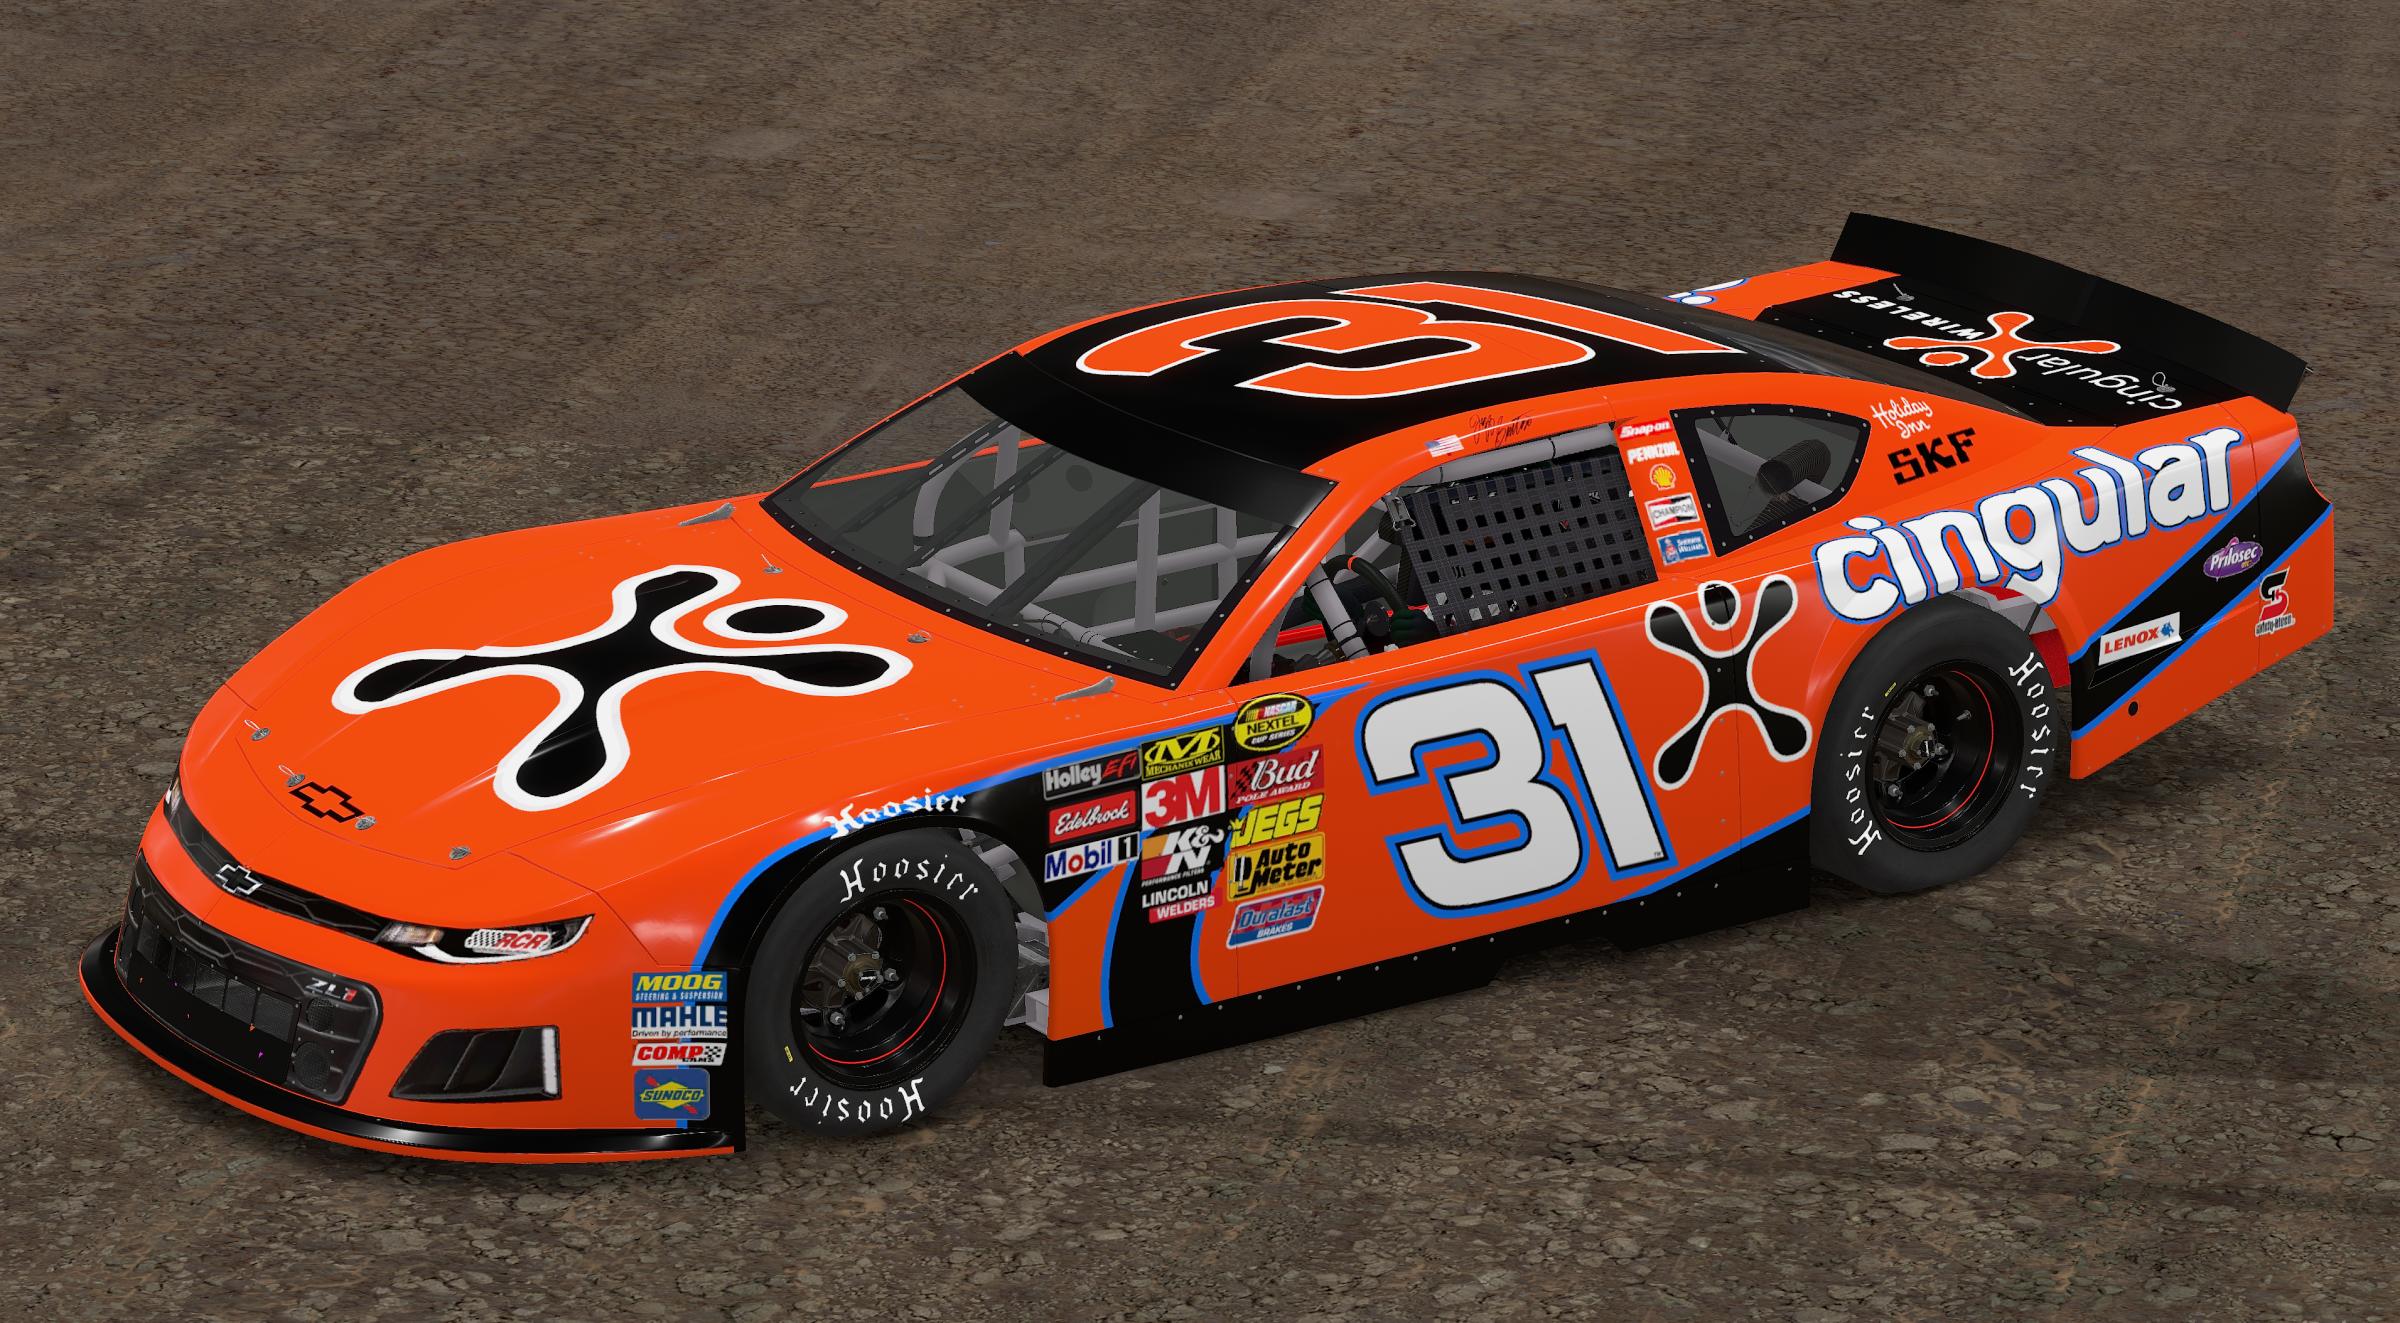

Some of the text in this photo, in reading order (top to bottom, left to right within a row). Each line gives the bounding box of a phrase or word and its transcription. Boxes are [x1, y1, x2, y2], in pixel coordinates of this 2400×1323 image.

[1832, 290, 1985, 340] WIRELESS
[1076, 281, 1746, 399] 31
[2017, 353, 2183, 410] cingular
[1870, 396, 1933, 429] Holiday
[1620, 421, 1671, 439] Snap-on
[1895, 419, 1931, 439] Inn
[1888, 427, 1976, 486] SKF
[1652, 503, 1694, 519] CHAMPION
[1813, 426, 2242, 624] cingular
[2210, 546, 2258, 571] Prilosec
[2104, 627, 2160, 655] LENOX
[1263, 700, 1298, 718] NASCAR
[1247, 715, 1299, 735] NEXTEL
[1251, 729, 1296, 745] CUP SERIES
[2008, 652, 2055, 798] Hoosier
[1194, 749, 1221, 764] WEAR
[1250, 749, 1319, 791] Bud
[1045, 751, 1137, 792] Holley EFI
[1357, 650, 1677, 917] 31
[1840, 706, 1882, 856] Hoosier
[1145, 766, 1220, 828] 3M
[1236, 781, 1311, 804] POLE AWARD
[820, 787, 966, 840] Hoosier
[1055, 800, 1129, 836] Edelbrock
[1230, 794, 1324, 848] JEGS
[1046, 836, 1132, 880] Mobil 1
[1256, 842, 1311, 869] Auto
[840, 854, 979, 903] Hoosier
[1253, 858, 1322, 888] Meter
[1142, 880, 1208, 909] LINCOLN
[1157, 896, 1215, 919] WELDERS
[1240, 896, 1314, 929] Duralast
[496, 932, 549, 950] RCR
[1256, 922, 1294, 939] BRAKES
[306, 977, 357, 1001] ZL1
[635, 991, 669, 1001] STEERING
[680, 991, 723, 1001] SUSPENSION
[636, 974, 724, 991] MOOG
[632, 1005, 727, 1028] MAHLE
[632, 1029, 727, 1038] Driven by performance
[637, 1046, 703, 1060] COMP
[643, 1090, 702, 1101] SUNOCO
[790, 1077, 926, 1124] Hoosier
